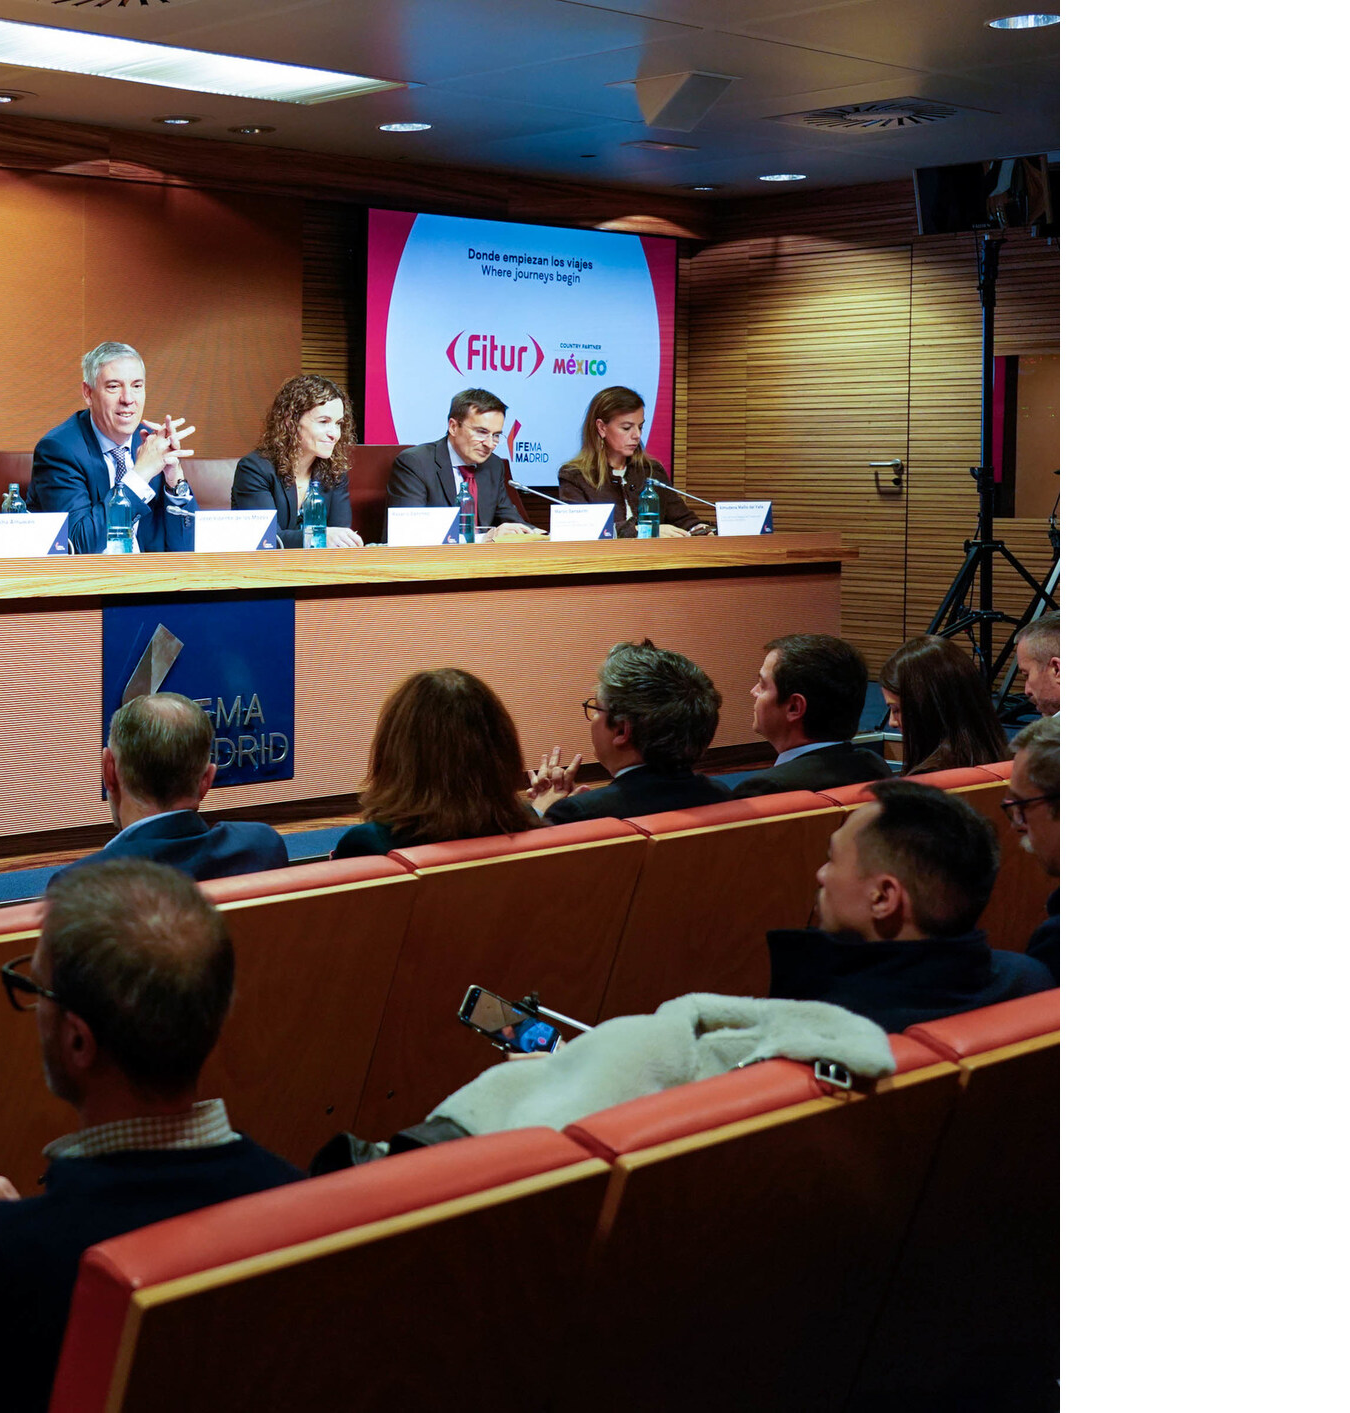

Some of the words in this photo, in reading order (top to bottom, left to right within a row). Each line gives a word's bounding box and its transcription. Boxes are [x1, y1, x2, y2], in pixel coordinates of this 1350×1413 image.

[468, 248, 500, 262] Donde
[502, 252, 549, 267] empiezan
[551, 256, 565, 268] los
[567, 257, 593, 273] viajes
[481, 264, 512, 278] Where
[512, 267, 555, 285] journeys
[556, 271, 581, 287] begin
[466, 334, 529, 373] Fitur
[559, 342, 581, 350] COUNTRY
[581, 343, 602, 351] PARTNER
[515, 441, 542, 452] IFEMA
[515, 452, 550, 463] MADRID
[210, 732, 289, 769] DRID
